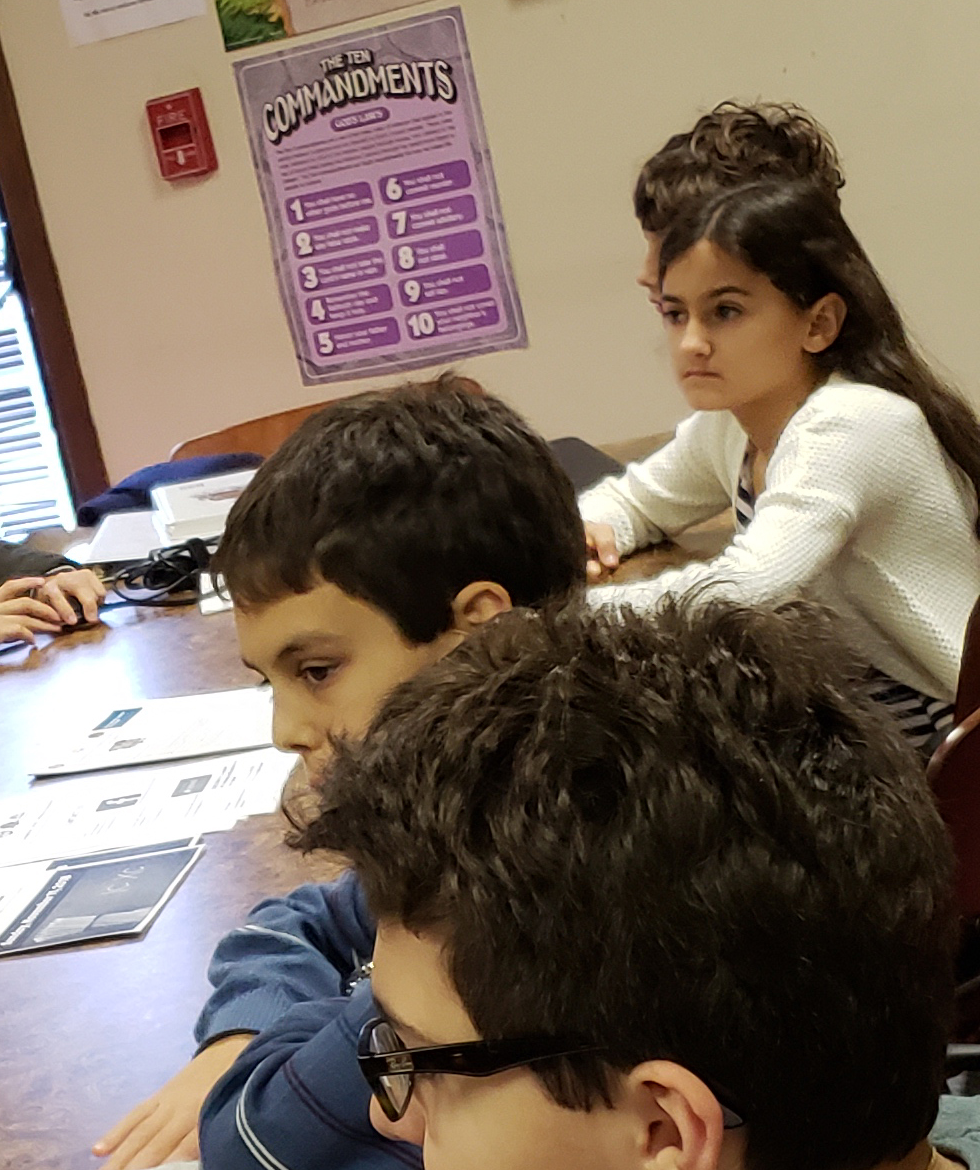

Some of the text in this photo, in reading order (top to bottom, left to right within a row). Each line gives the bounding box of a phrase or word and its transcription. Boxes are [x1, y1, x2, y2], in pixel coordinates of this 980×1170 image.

[319, 49, 371, 73] THE TEN
[261, 59, 455, 142] COMMANDMENTS
[385, 177, 402, 200] 6
[289, 198, 304, 221] 1
[391, 210, 406, 234] 7
[295, 231, 313, 255] 2
[397, 245, 414, 269] 8
[301, 265, 318, 288] 3
[403, 279, 420, 302] 9
[310, 299, 325, 320] 4
[407, 311, 434, 336] 10
[317, 331, 333, 353] 5
